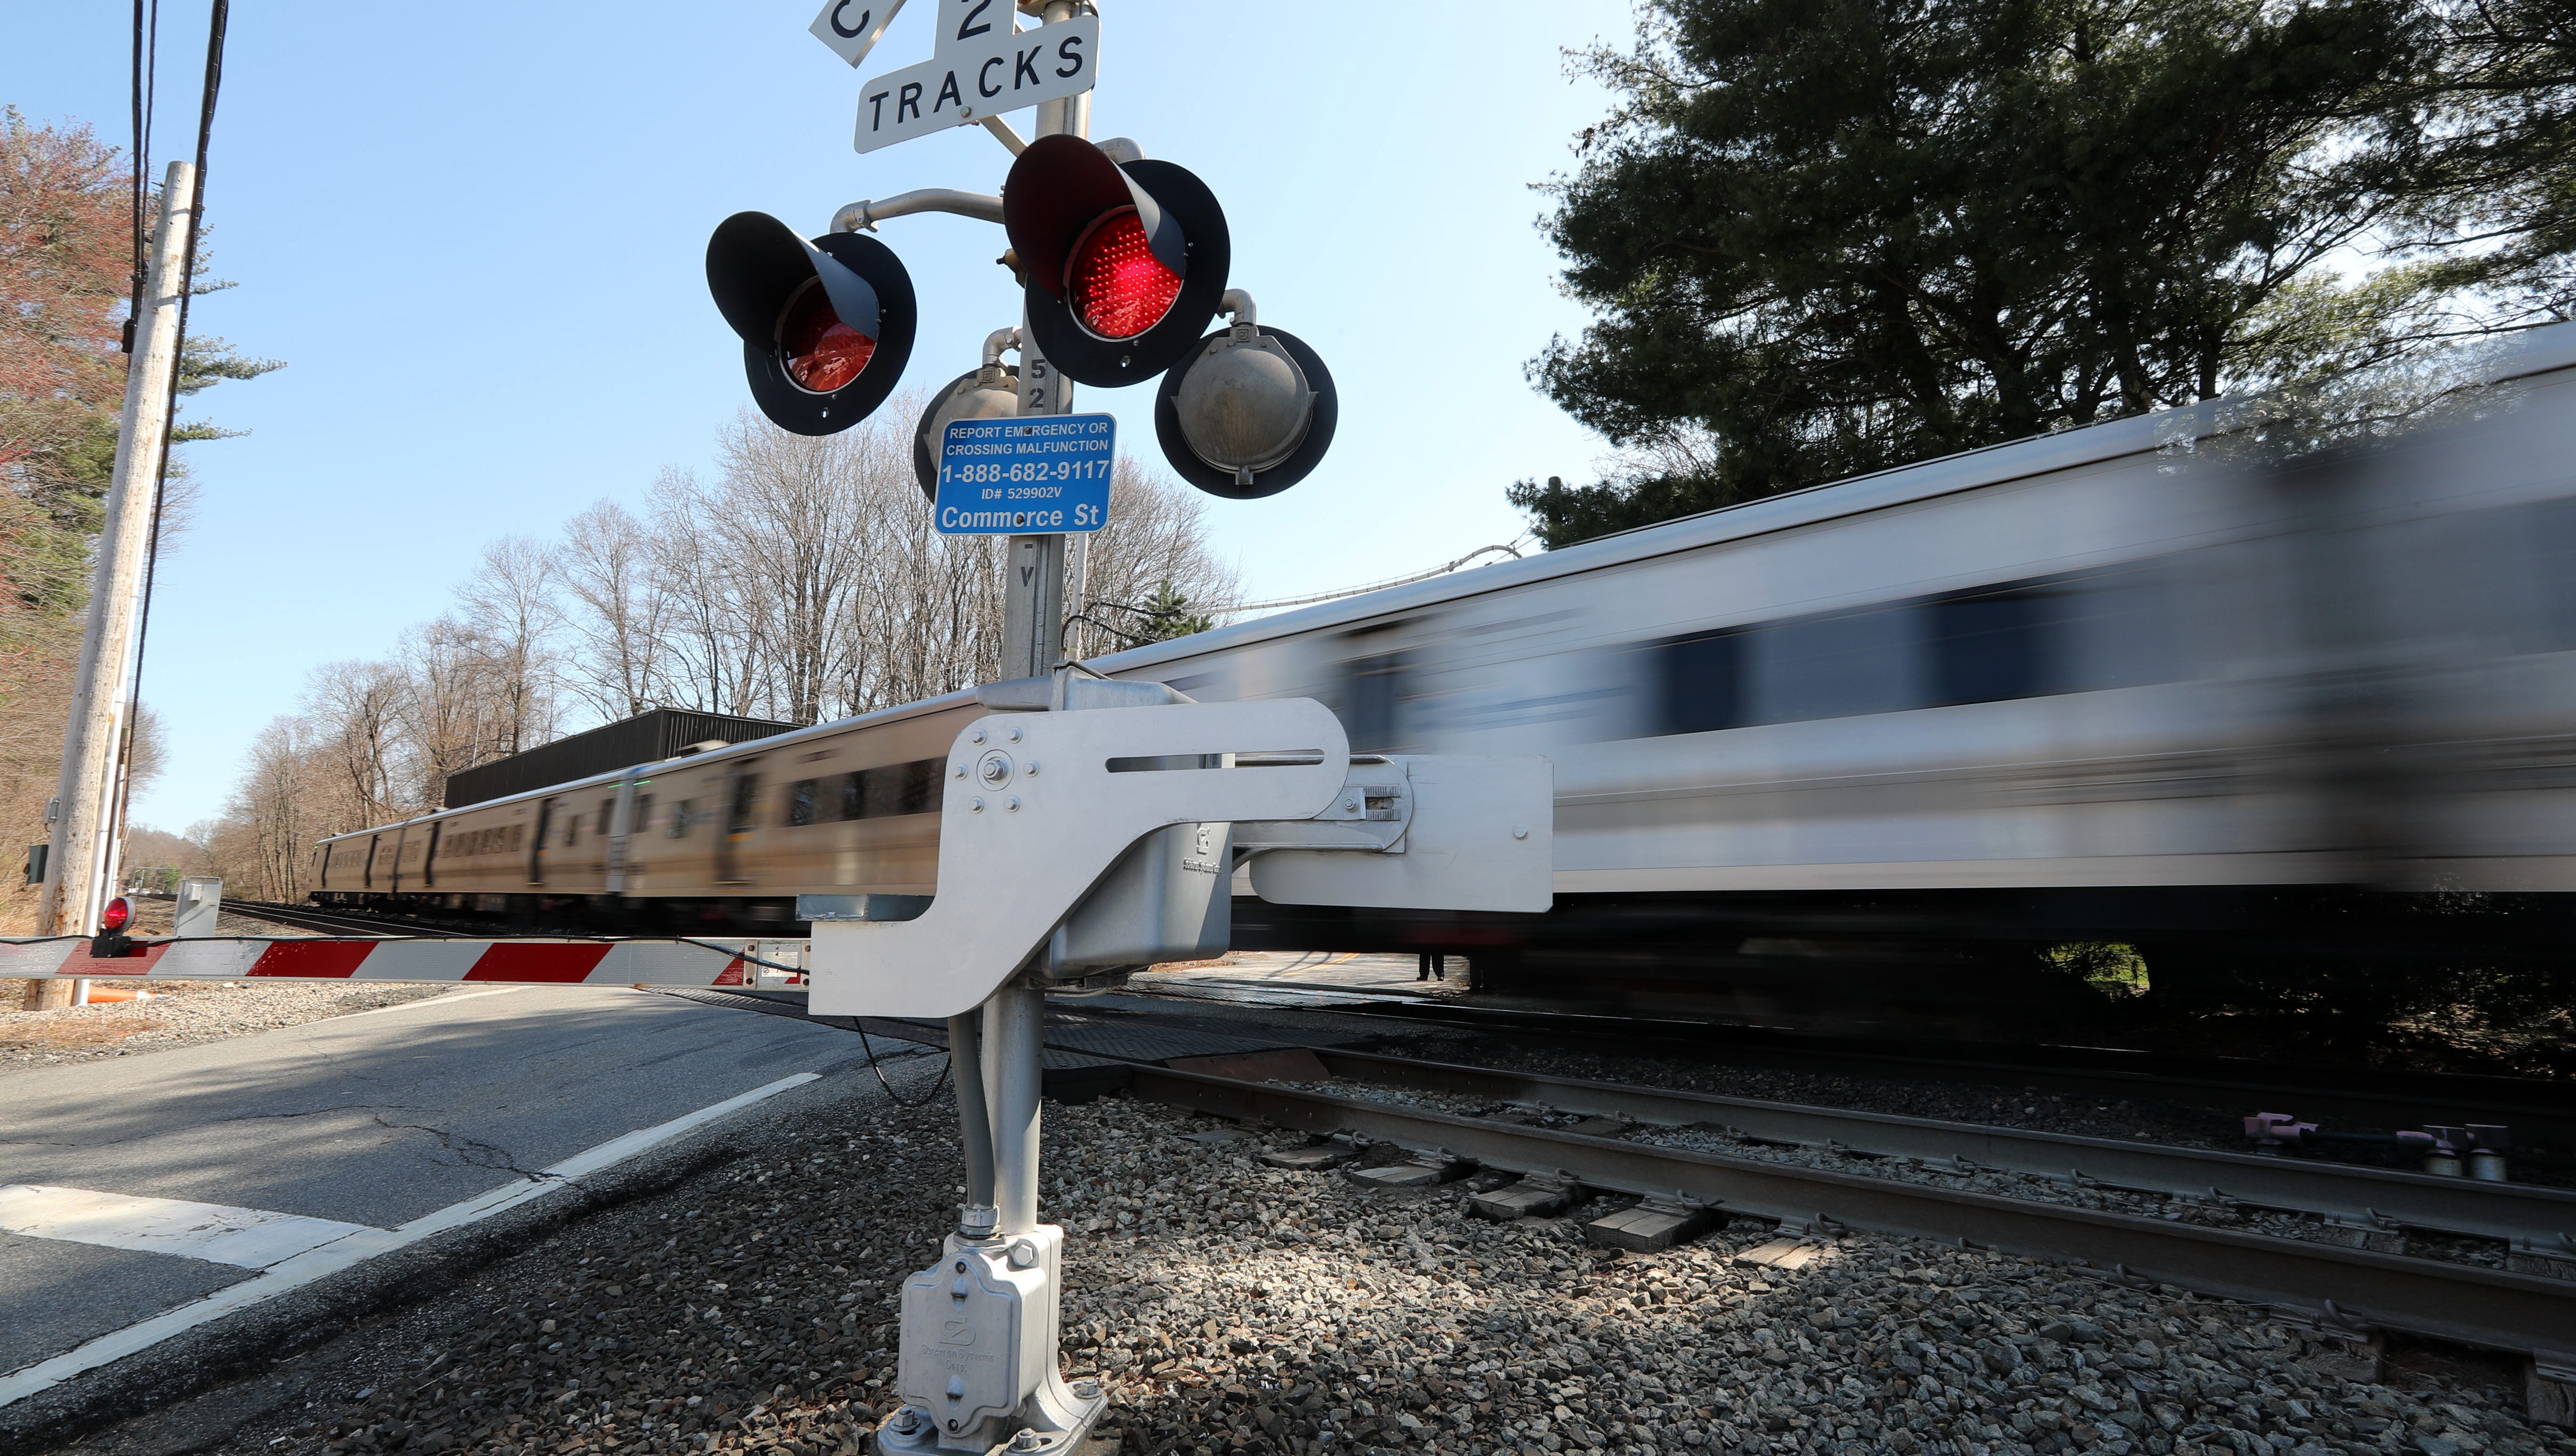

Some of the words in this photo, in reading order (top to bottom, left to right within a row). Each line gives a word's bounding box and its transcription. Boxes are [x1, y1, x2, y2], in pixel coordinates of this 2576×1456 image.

[831, 0, 869, 38] C
[957, 0, 990, 40] 2
[869, 36, 1083, 132] TRACKS
[950, 426, 1001, 438] REPORT
[1005, 423, 1086, 437] EMERGENCY
[1089, 423, 1108, 433] OR
[946, 443, 1012, 455] CROSSING
[1016, 439, 1108, 454] MALFUNCTION
[942, 460, 1110, 483] 1-888-682-9117
[982, 488, 1002, 500] ID#
[1007, 486, 1063, 499] 529902V
[942, 506, 1063, 528] Commerce
[1074, 503, 1099, 526] St
